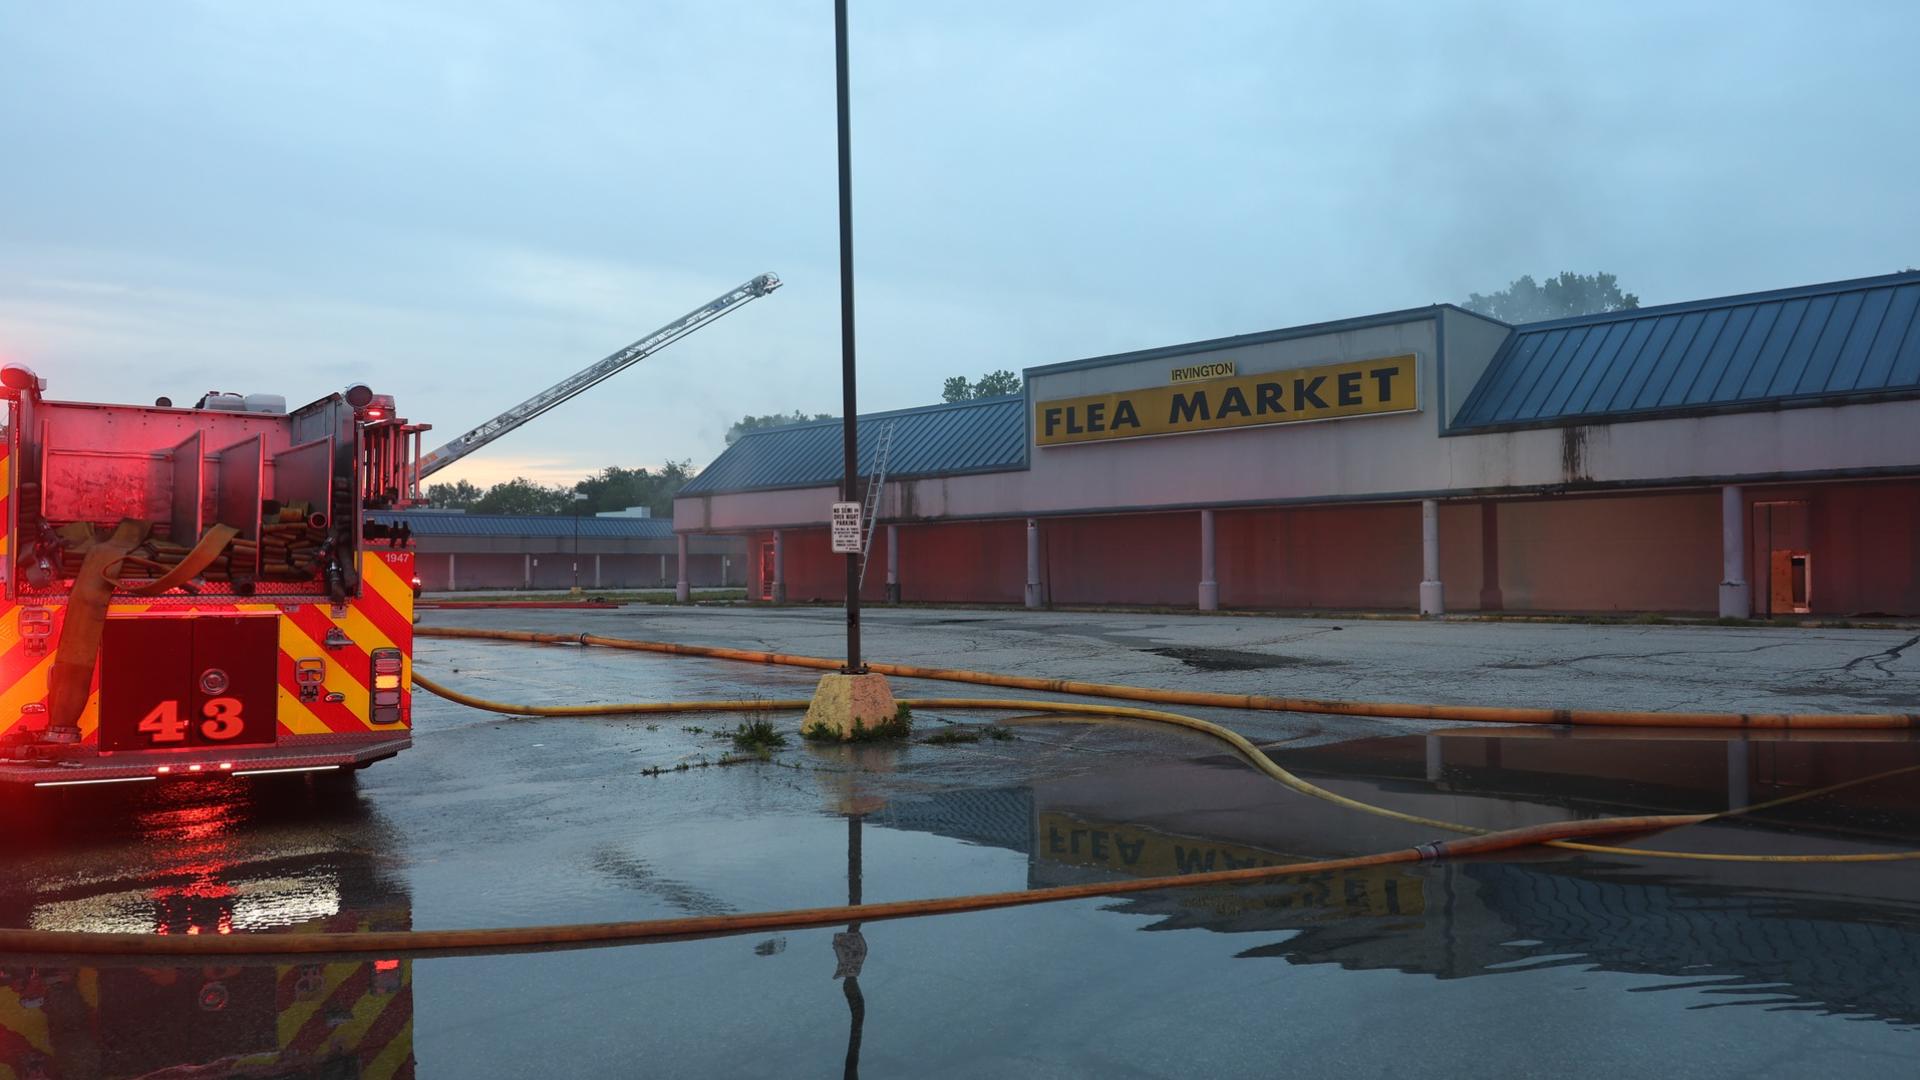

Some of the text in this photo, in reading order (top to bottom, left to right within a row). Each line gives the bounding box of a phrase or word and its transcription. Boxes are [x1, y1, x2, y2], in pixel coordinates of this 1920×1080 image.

[1171, 362, 1233, 381] IRVINGTON
[1045, 367, 1399, 437] FLEA MARKET
[385, 552, 409, 563] 1947
[138, 697, 244, 743] 43
